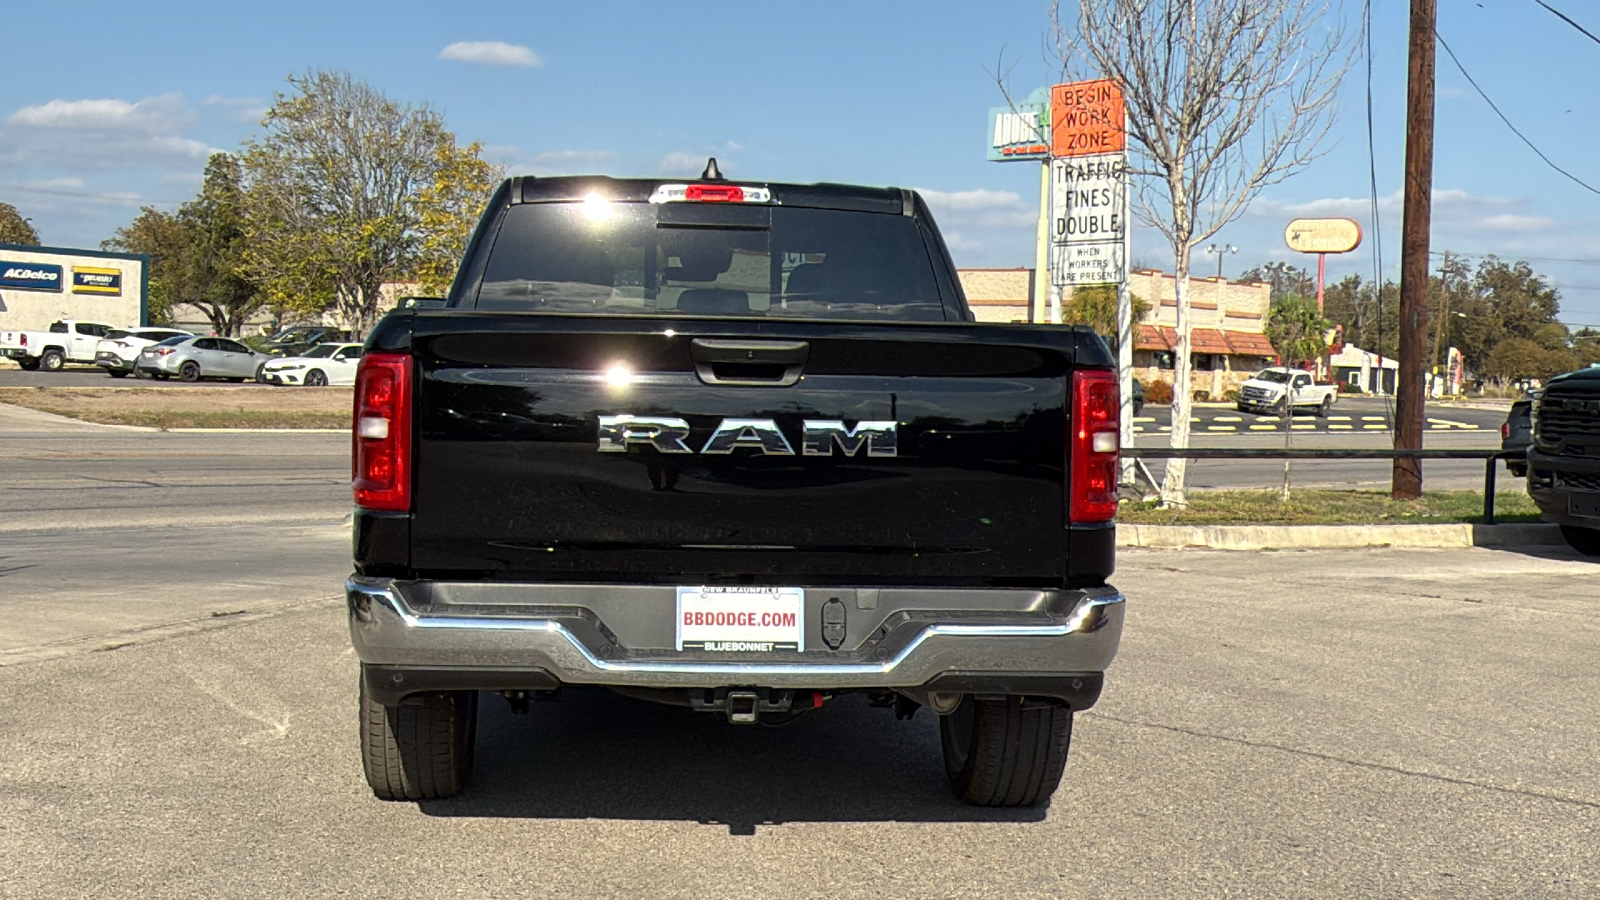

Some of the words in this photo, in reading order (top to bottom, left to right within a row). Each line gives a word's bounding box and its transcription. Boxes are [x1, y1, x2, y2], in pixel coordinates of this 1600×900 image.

[1064, 86, 1111, 106] BEGIN
[1066, 108, 1110, 128] WORK
[1067, 131, 1109, 149] ZONE
[1056, 161, 1121, 183] TRAFFIC
[1066, 188, 1110, 208] FINES
[1057, 214, 1118, 235] DOUBLE
[1077, 247, 1100, 257] WHEN
[1068, 260, 1108, 269] WORKERS
[3, 268, 58, 281] ACDelco
[1060, 273, 1076, 281] ARE
[1081, 271, 1117, 280] PRESENT
[597, 415, 898, 458] RAM
[684, 612, 796, 627] BBDODGE.COM
[704, 642, 774, 652] BLUEBONNET
